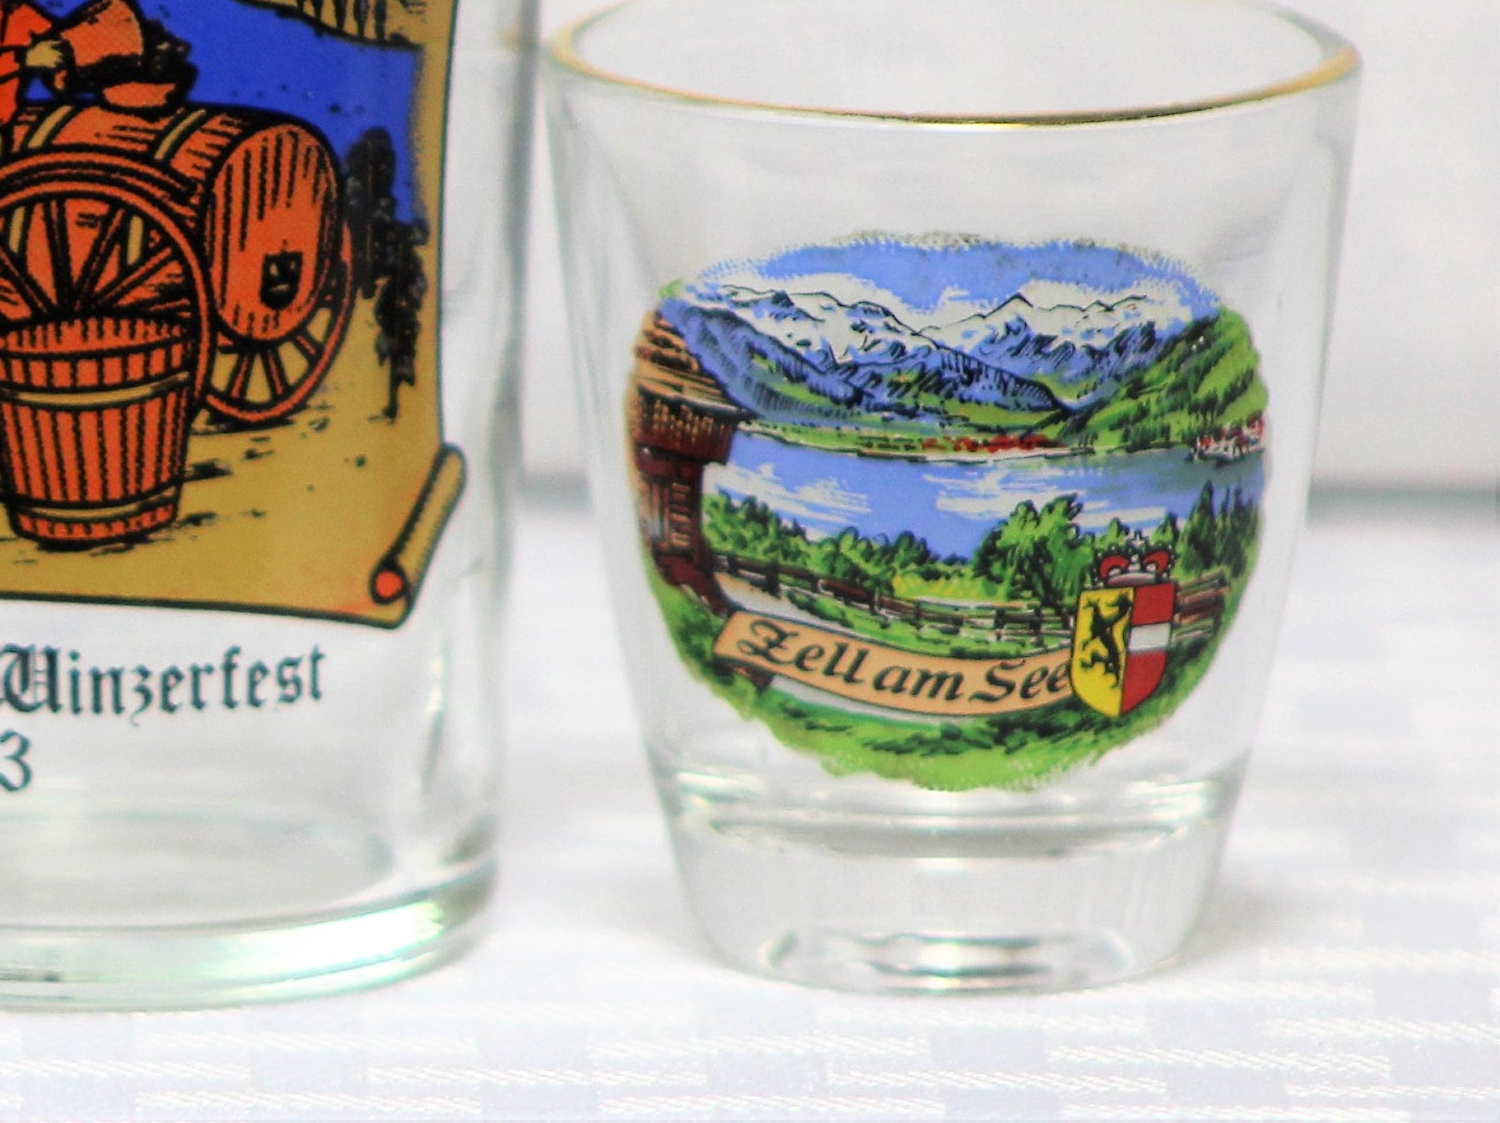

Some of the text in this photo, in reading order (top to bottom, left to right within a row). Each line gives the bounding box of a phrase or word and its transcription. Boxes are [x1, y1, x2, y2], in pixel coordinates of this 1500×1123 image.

[737, 618, 1071, 705] Zell am See
